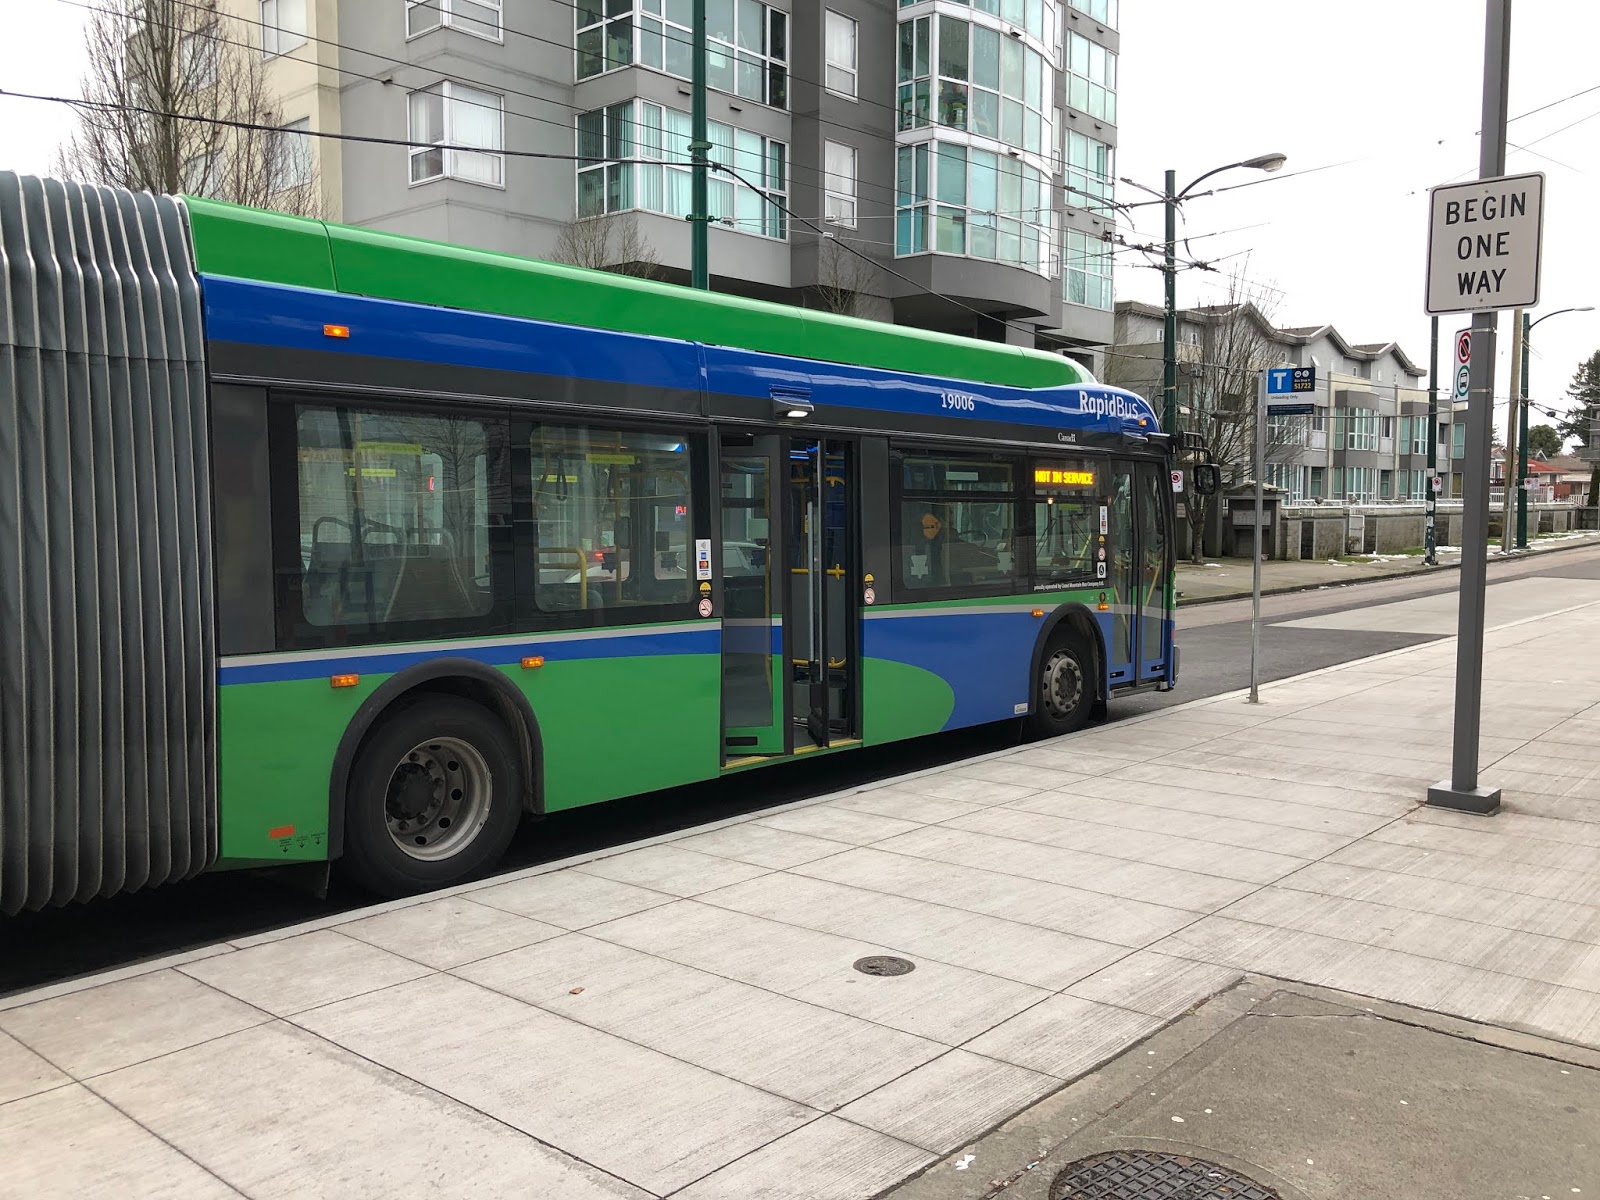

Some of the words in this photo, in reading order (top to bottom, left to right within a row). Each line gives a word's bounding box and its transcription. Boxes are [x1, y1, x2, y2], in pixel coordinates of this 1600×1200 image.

[1446, 192, 1526, 225] BEGIN
[1457, 231, 1510, 260] ONE
[1457, 268, 1507, 296] WAY
[1273, 372, 1287, 390] T
[940, 392, 975, 411] 19006
[1079, 390, 1138, 420] RapidBus
[1035, 470, 1050, 483] NOT
[1052, 471, 1062, 483] IN
[1063, 471, 1093, 485] SERVICE
